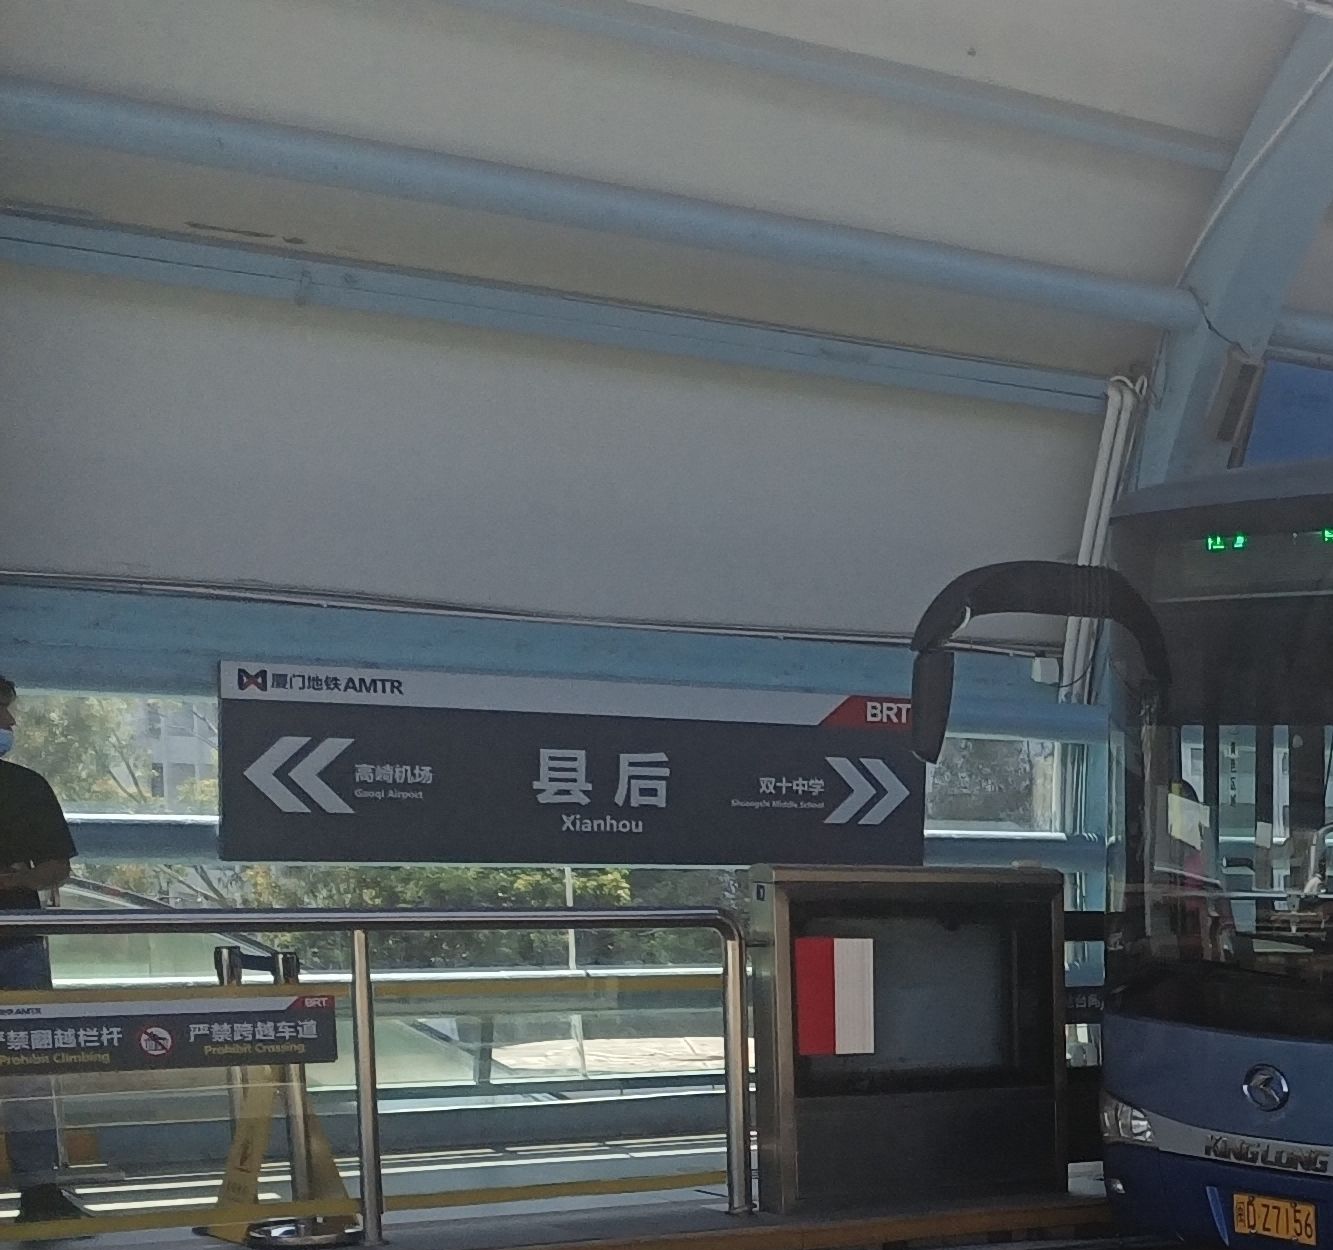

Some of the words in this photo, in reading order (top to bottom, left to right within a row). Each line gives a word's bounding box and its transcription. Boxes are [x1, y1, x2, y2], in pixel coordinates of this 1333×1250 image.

[866, 701, 912, 724] BRT
[354, 763, 433, 785] 高崎机场
[532, 748, 671, 808] 县后
[759, 776, 825, 796] 双十中学
[561, 814, 643, 833] Xianhou
[0, 1026, 122, 1051] 禁翻越栏杆
